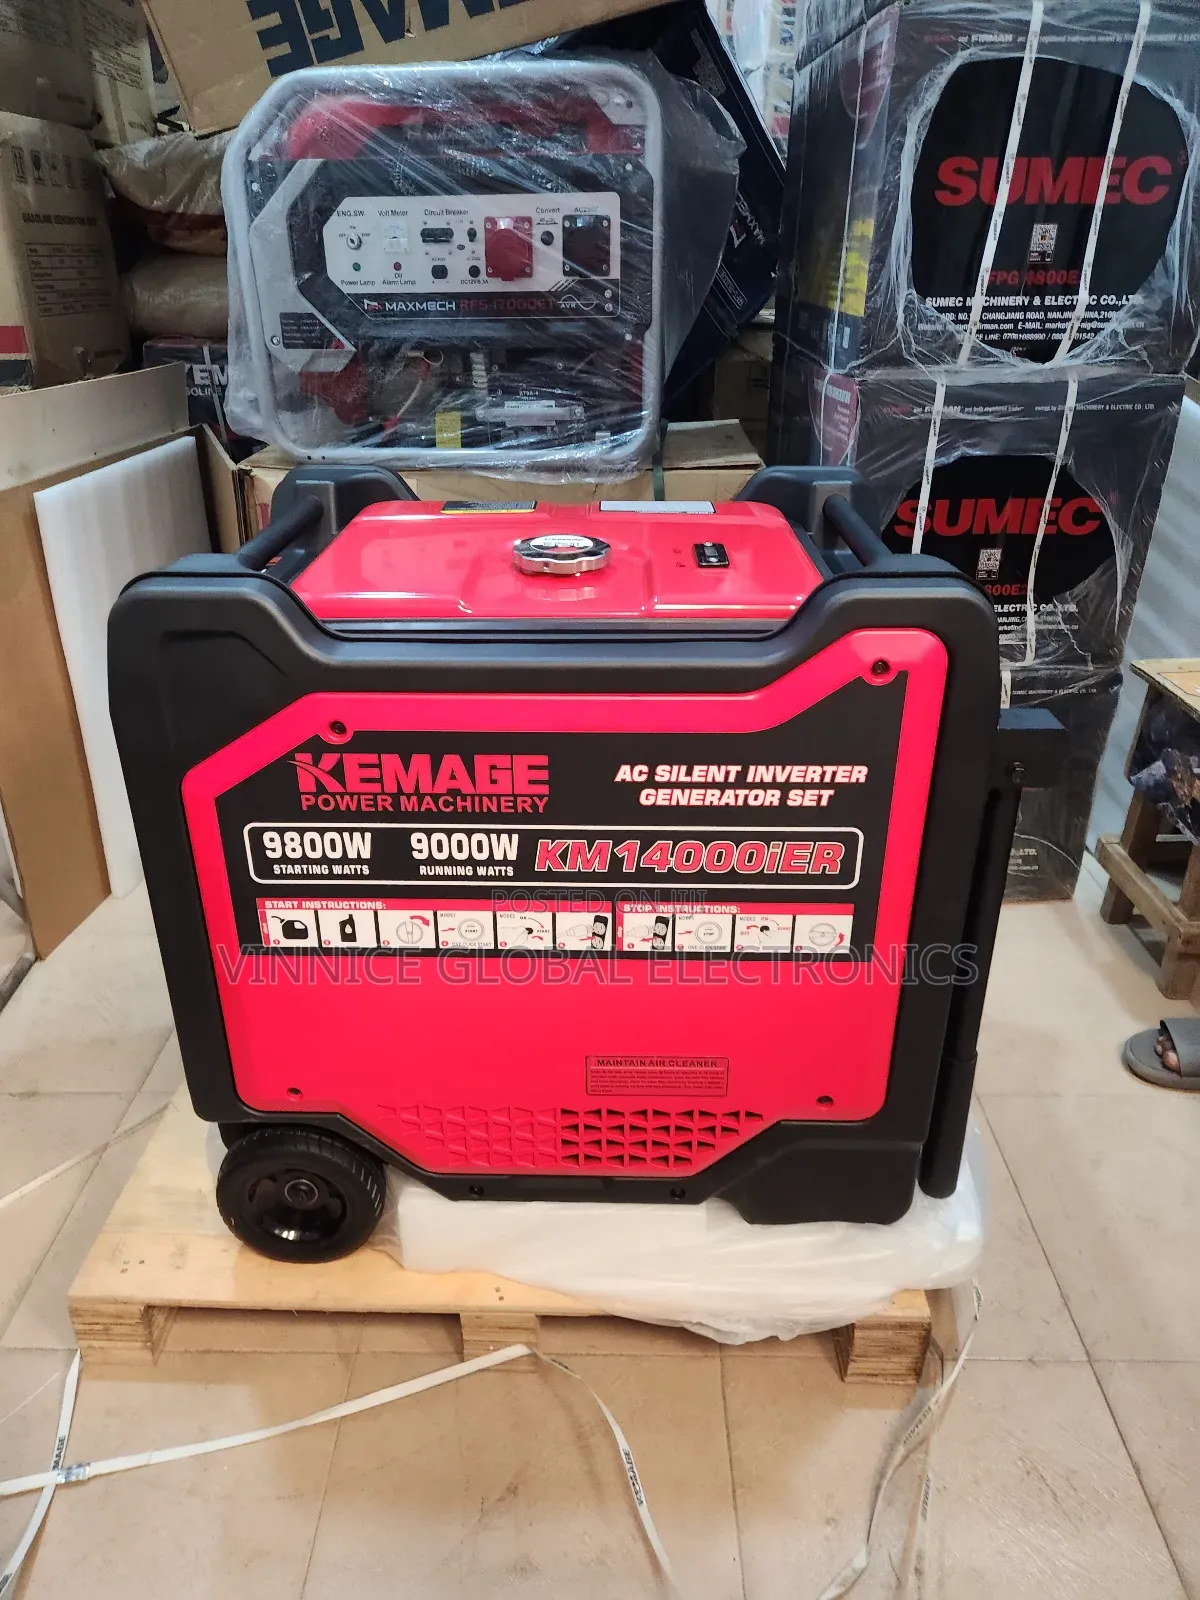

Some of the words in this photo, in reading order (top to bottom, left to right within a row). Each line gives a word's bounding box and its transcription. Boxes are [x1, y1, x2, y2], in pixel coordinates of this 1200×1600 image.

[934, 156, 1173, 206] SUMEC
[536, 206, 561, 214] Convert
[386, 301, 455, 311] MAXMECH
[926, 297, 963, 307] SUMEC
[1033, 296, 1041, 306] &
[981, 312, 1025, 320] CHANGJIANG
[1026, 312, 1046, 320] ROAD,
[894, 496, 1103, 538] SUMEC
[288, 753, 550, 795] KEMAGE
[614, 765, 648, 783] AC
[654, 765, 742, 783] SILENT
[747, 765, 869, 784] INVERTER
[300, 794, 394, 812] POWER
[399, 796, 549, 814] MACHINERY
[639, 788, 780, 806] GENERATOR
[786, 789, 834, 807] SET
[262, 831, 372, 860] 9800W
[410, 832, 519, 860] 9000W
[534, 839, 845, 875] KM14000iER
[273, 864, 328, 875] STARTING
[332, 865, 370, 876] WATTS
[419, 865, 473, 876] RUNNING
[477, 866, 514, 877] WATTS
[265, 900, 299, 909] START
[302, 900, 386, 910] INSTRUCTIONS:
[623, 904, 653, 913] STOP
[655, 904, 741, 914] INSTRUCTIONS:
